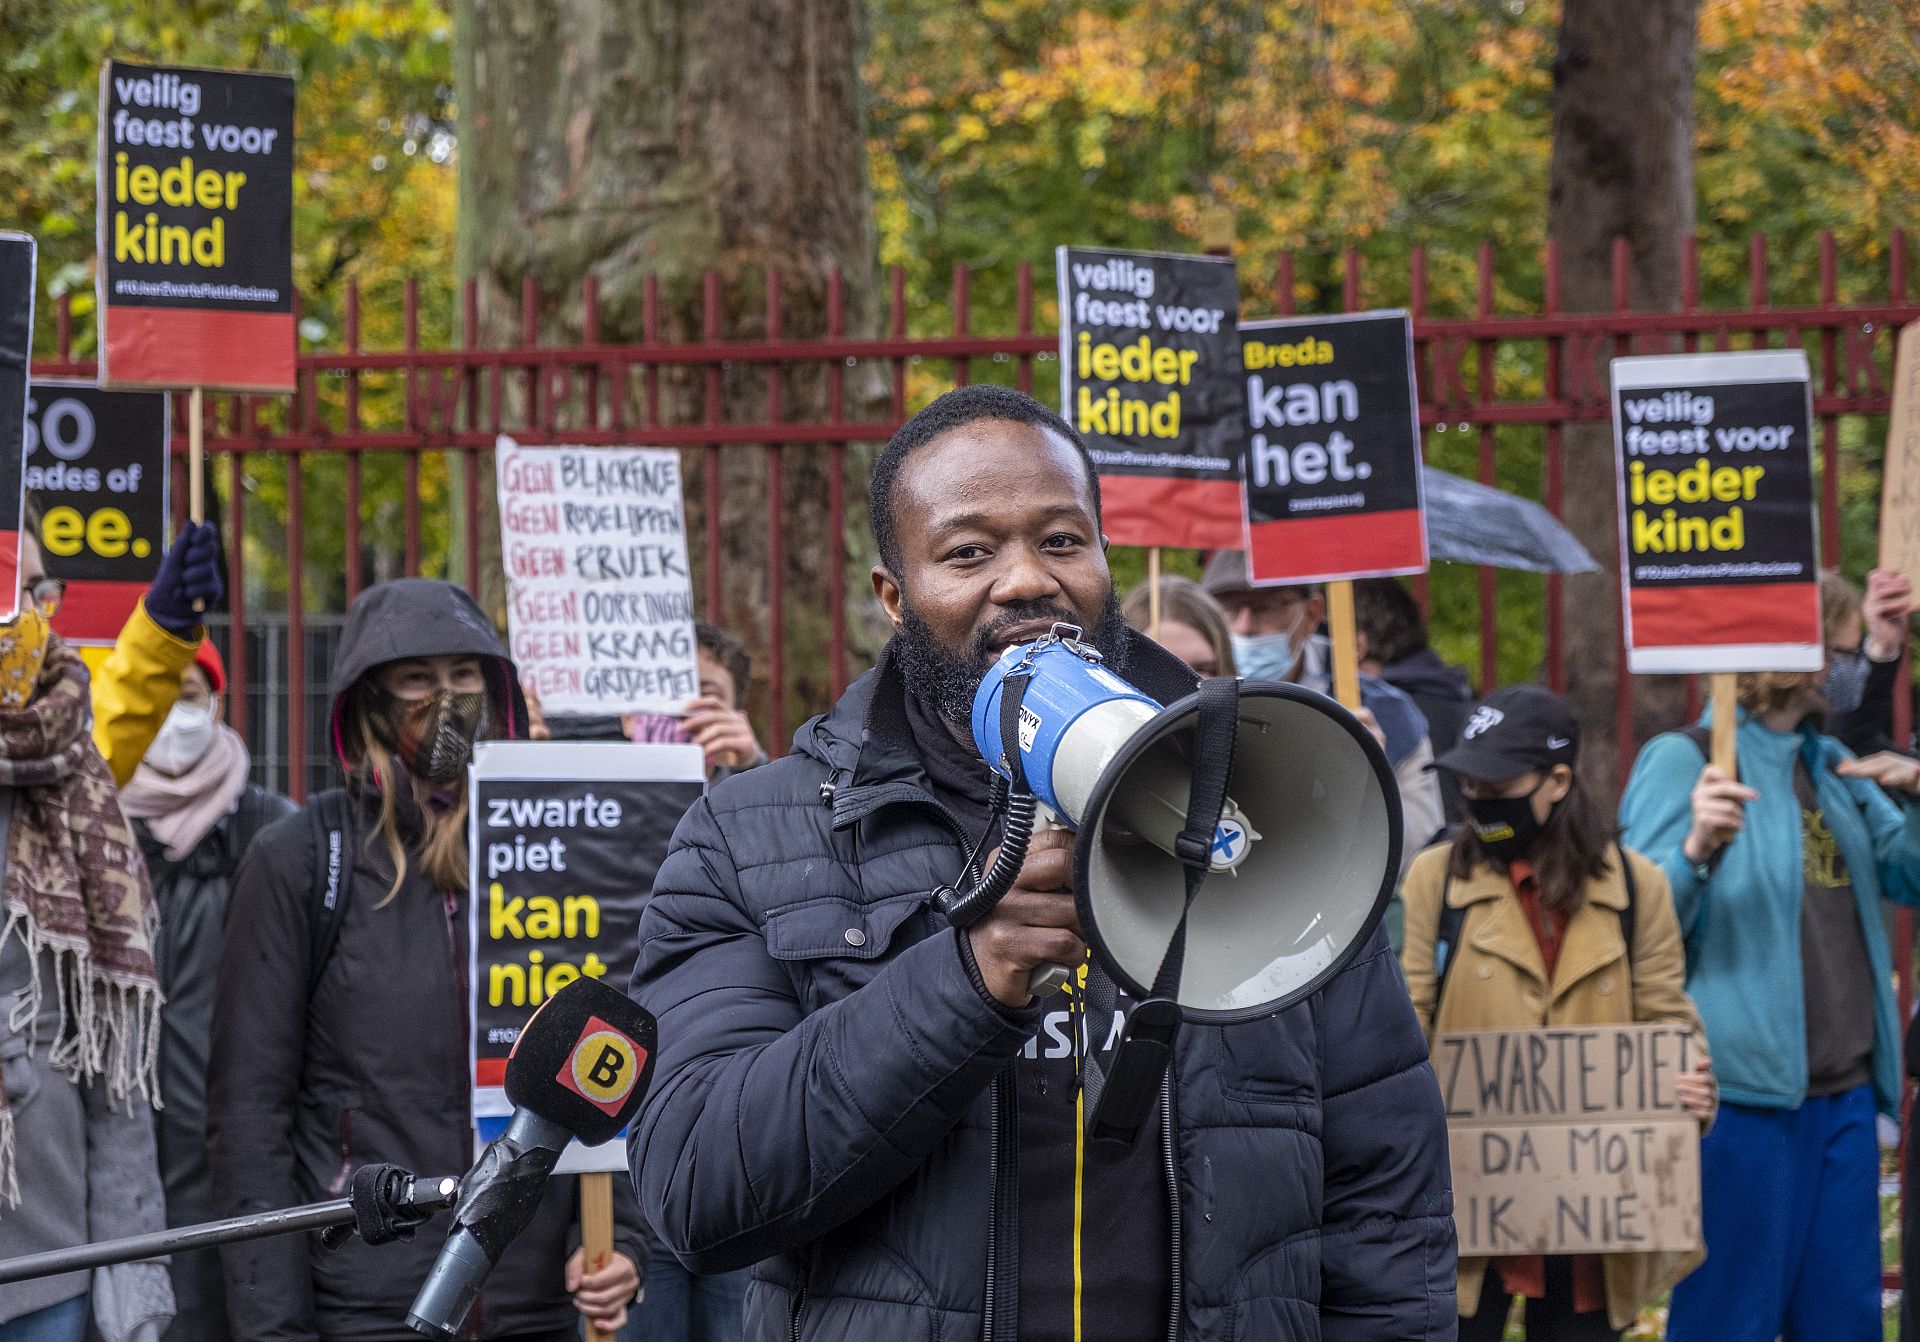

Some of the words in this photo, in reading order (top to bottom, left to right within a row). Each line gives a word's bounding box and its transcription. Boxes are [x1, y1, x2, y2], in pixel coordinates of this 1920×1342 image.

[115, 73, 201, 116] veilig
[114, 109, 195, 149] feest
[201, 123, 278, 155] voor
[115, 151, 247, 210] ieder
[115, 211, 225, 267] kind
[1073, 259, 1154, 298] veilig
[1075, 292, 1151, 328] feest
[1156, 304, 1225, 334] voor
[1078, 331, 1198, 386] ieder
[1243, 336, 1334, 370] Breda
[1078, 386, 1181, 439] kind
[1247, 374, 1359, 429] kan
[1624, 390, 1714, 425] veilig
[1251, 430, 1372, 488] het.
[1625, 425, 1710, 456] feest
[1715, 424, 1795, 453] voor
[26, 461, 101, 492] ades
[106, 463, 143, 493] of
[503, 453, 556, 495] GEEN
[1629, 457, 1765, 505] ieder
[41, 505, 152, 558] ee.
[506, 497, 560, 535] GEEN
[1632, 505, 1745, 554] kind
[511, 541, 566, 578] GEEN
[574, 543, 687, 581] PRUIK
[515, 587, 579, 625] GEEN
[515, 628, 581, 661] GEEN
[586, 628, 691, 662] KRAAG
[520, 664, 583, 697] GEEN
[487, 793, 622, 828] zwarte
[488, 834, 566, 879] piet
[489, 882, 600, 939] kan
[588, 1044, 624, 1088] B
[1443, 1032, 1607, 1119] ZWARTE
[1616, 1030, 1696, 1113] PIET
[1482, 1130, 1541, 1176] DA
[1569, 1127, 1656, 1174] MOT
[1469, 1196, 1522, 1247] IK
[1557, 1191, 1645, 1247] NIE
